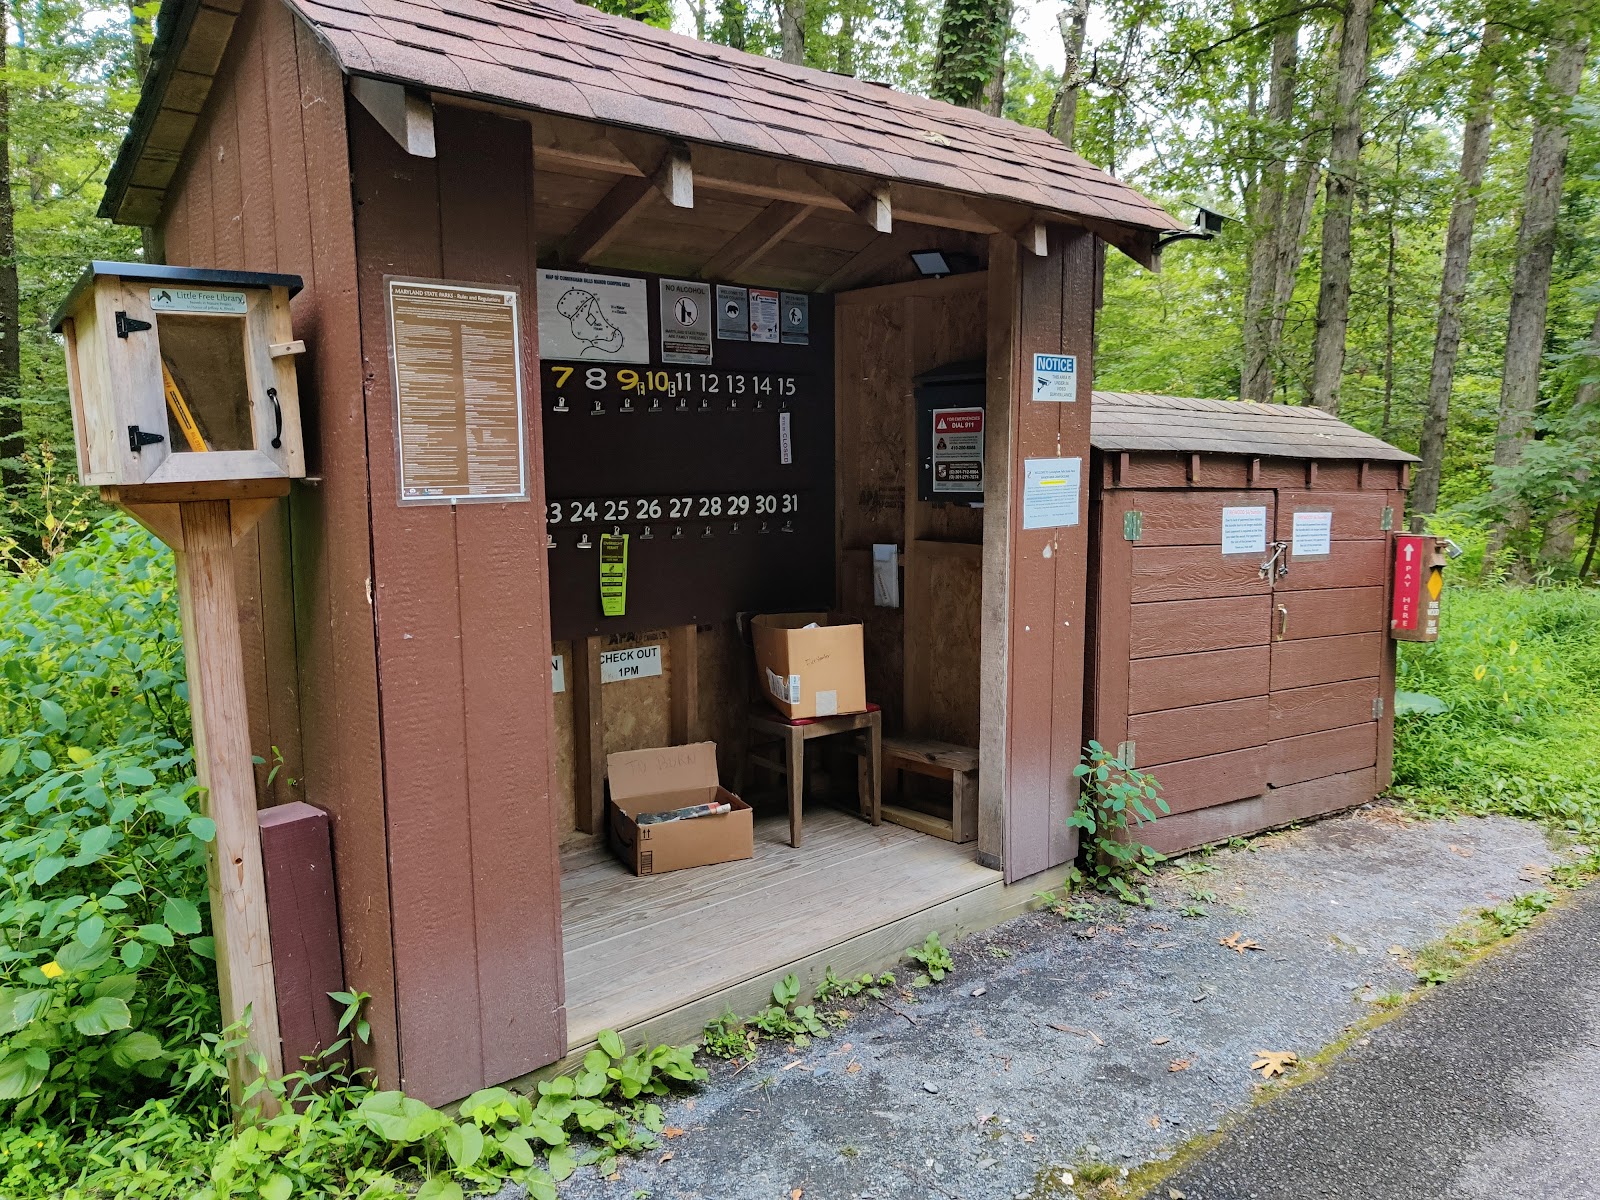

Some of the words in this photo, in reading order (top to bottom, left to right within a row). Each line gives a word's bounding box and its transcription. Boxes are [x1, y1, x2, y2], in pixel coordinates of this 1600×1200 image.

[666, 284, 674, 292] NO
[676, 286, 706, 294] ALCOHOL
[176, 292, 197, 300] Little
[198, 293, 215, 301] Free
[217, 294, 244, 304] Library
[1038, 357, 1072, 372] NOTICE
[551, 367, 574, 388] 7
[585, 368, 607, 390] 8
[617, 370, 639, 391] 9
[646, 372, 668, 391] 10
[676, 372, 691, 392] 11
[700, 374, 719, 393] 12
[727, 375, 745, 394] 13
[753, 376, 772, 395] 14
[778, 378, 796, 395] 15
[570, 502, 598, 522] 24
[604, 500, 630, 521] 25
[636, 499, 662, 519] 26
[669, 498, 693, 518] 27
[699, 497, 722, 517] 28
[727, 496, 750, 515] 29
[755, 495, 777, 514] 30
[782, 494, 798, 513] 31
[1404, 566, 1412, 587] PAY
[1402, 597, 1410, 626] HERE
[600, 651, 634, 664] CHECK
[637, 648, 657, 659] OUT
[618, 666, 639, 677] 1PM
